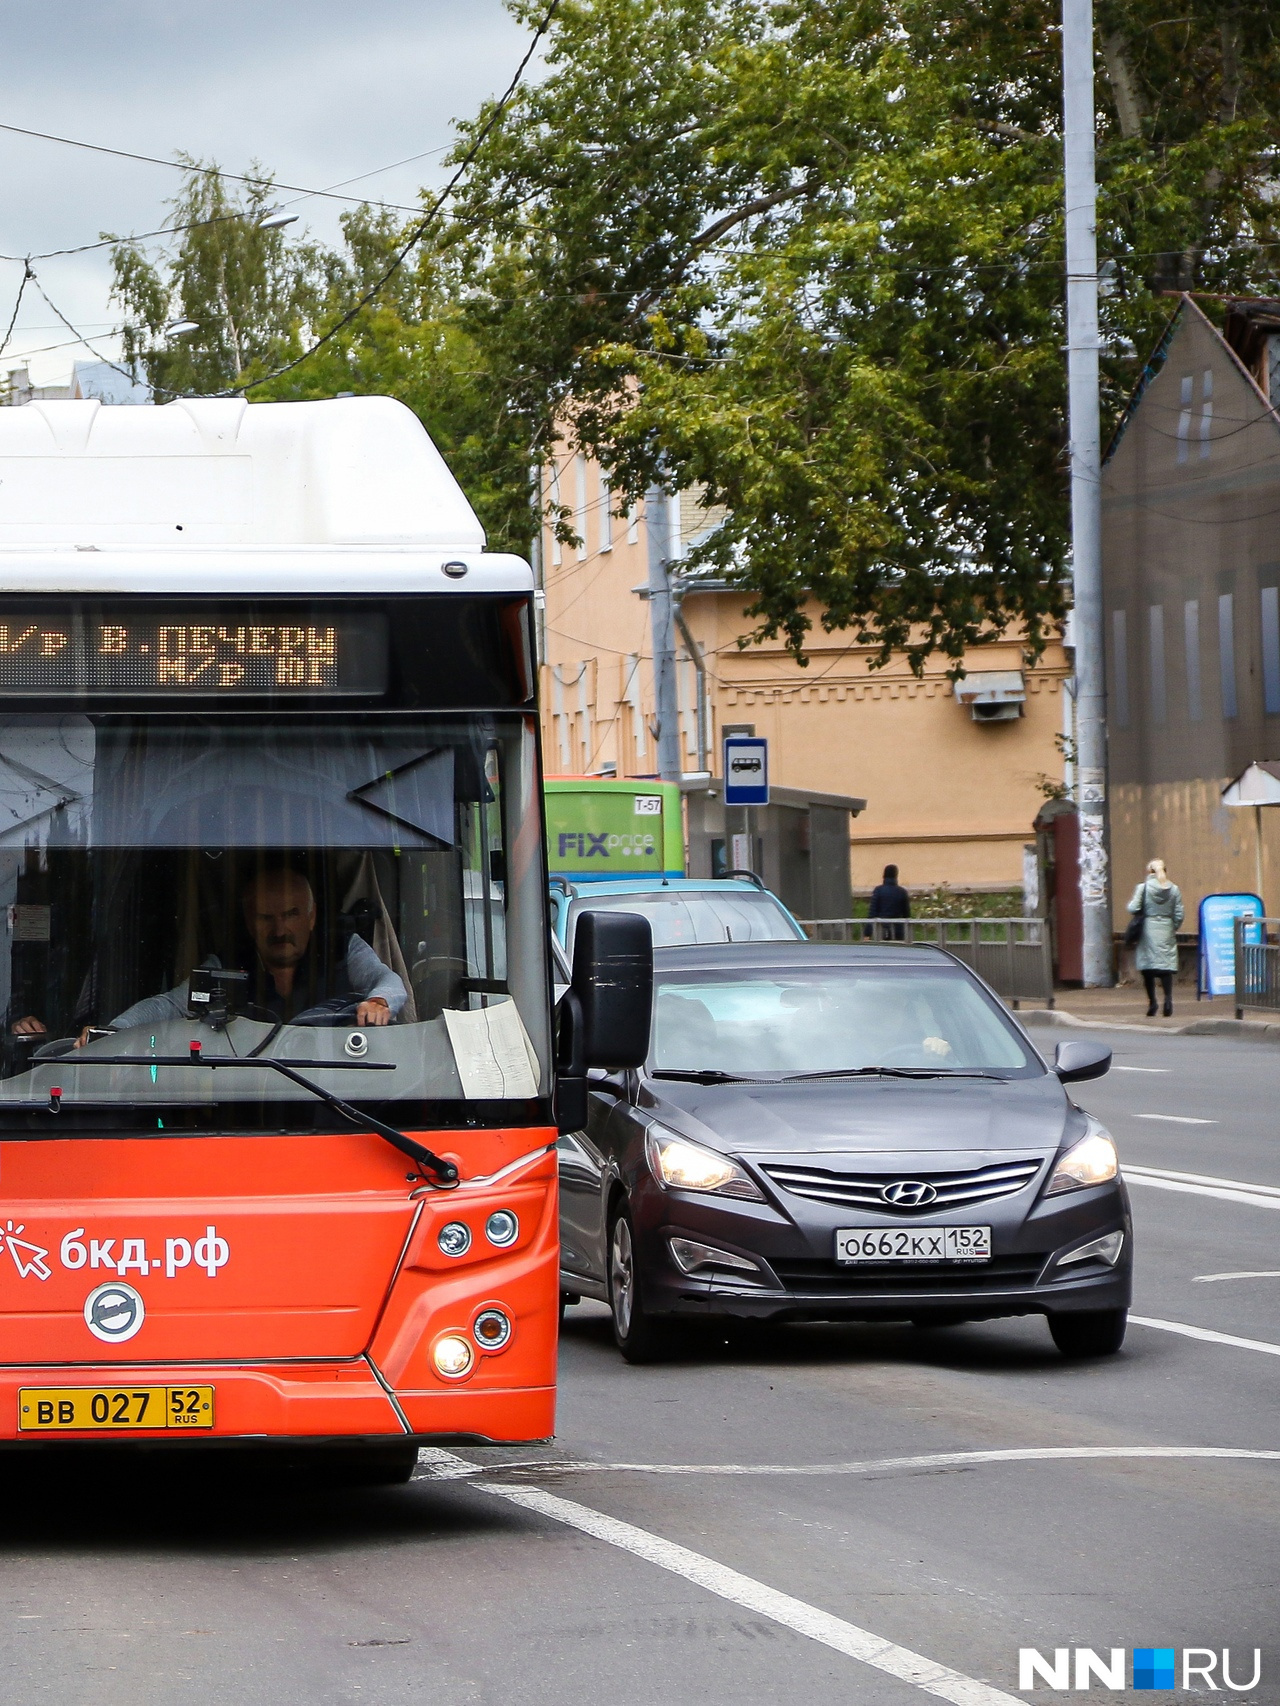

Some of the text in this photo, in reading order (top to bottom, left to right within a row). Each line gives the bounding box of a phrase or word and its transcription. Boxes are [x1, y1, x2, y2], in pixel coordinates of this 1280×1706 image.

[276, 656, 335, 685] ЮГ
[636, 799, 660, 811] Т-57
[608, 834, 654, 850] price
[948, 1229, 984, 1247] 152
[60, 1226, 230, 1278] бкд.рф
[37, 1390, 200, 1424] ВВ 027 52
[174, 1415, 198, 1424] RUS
